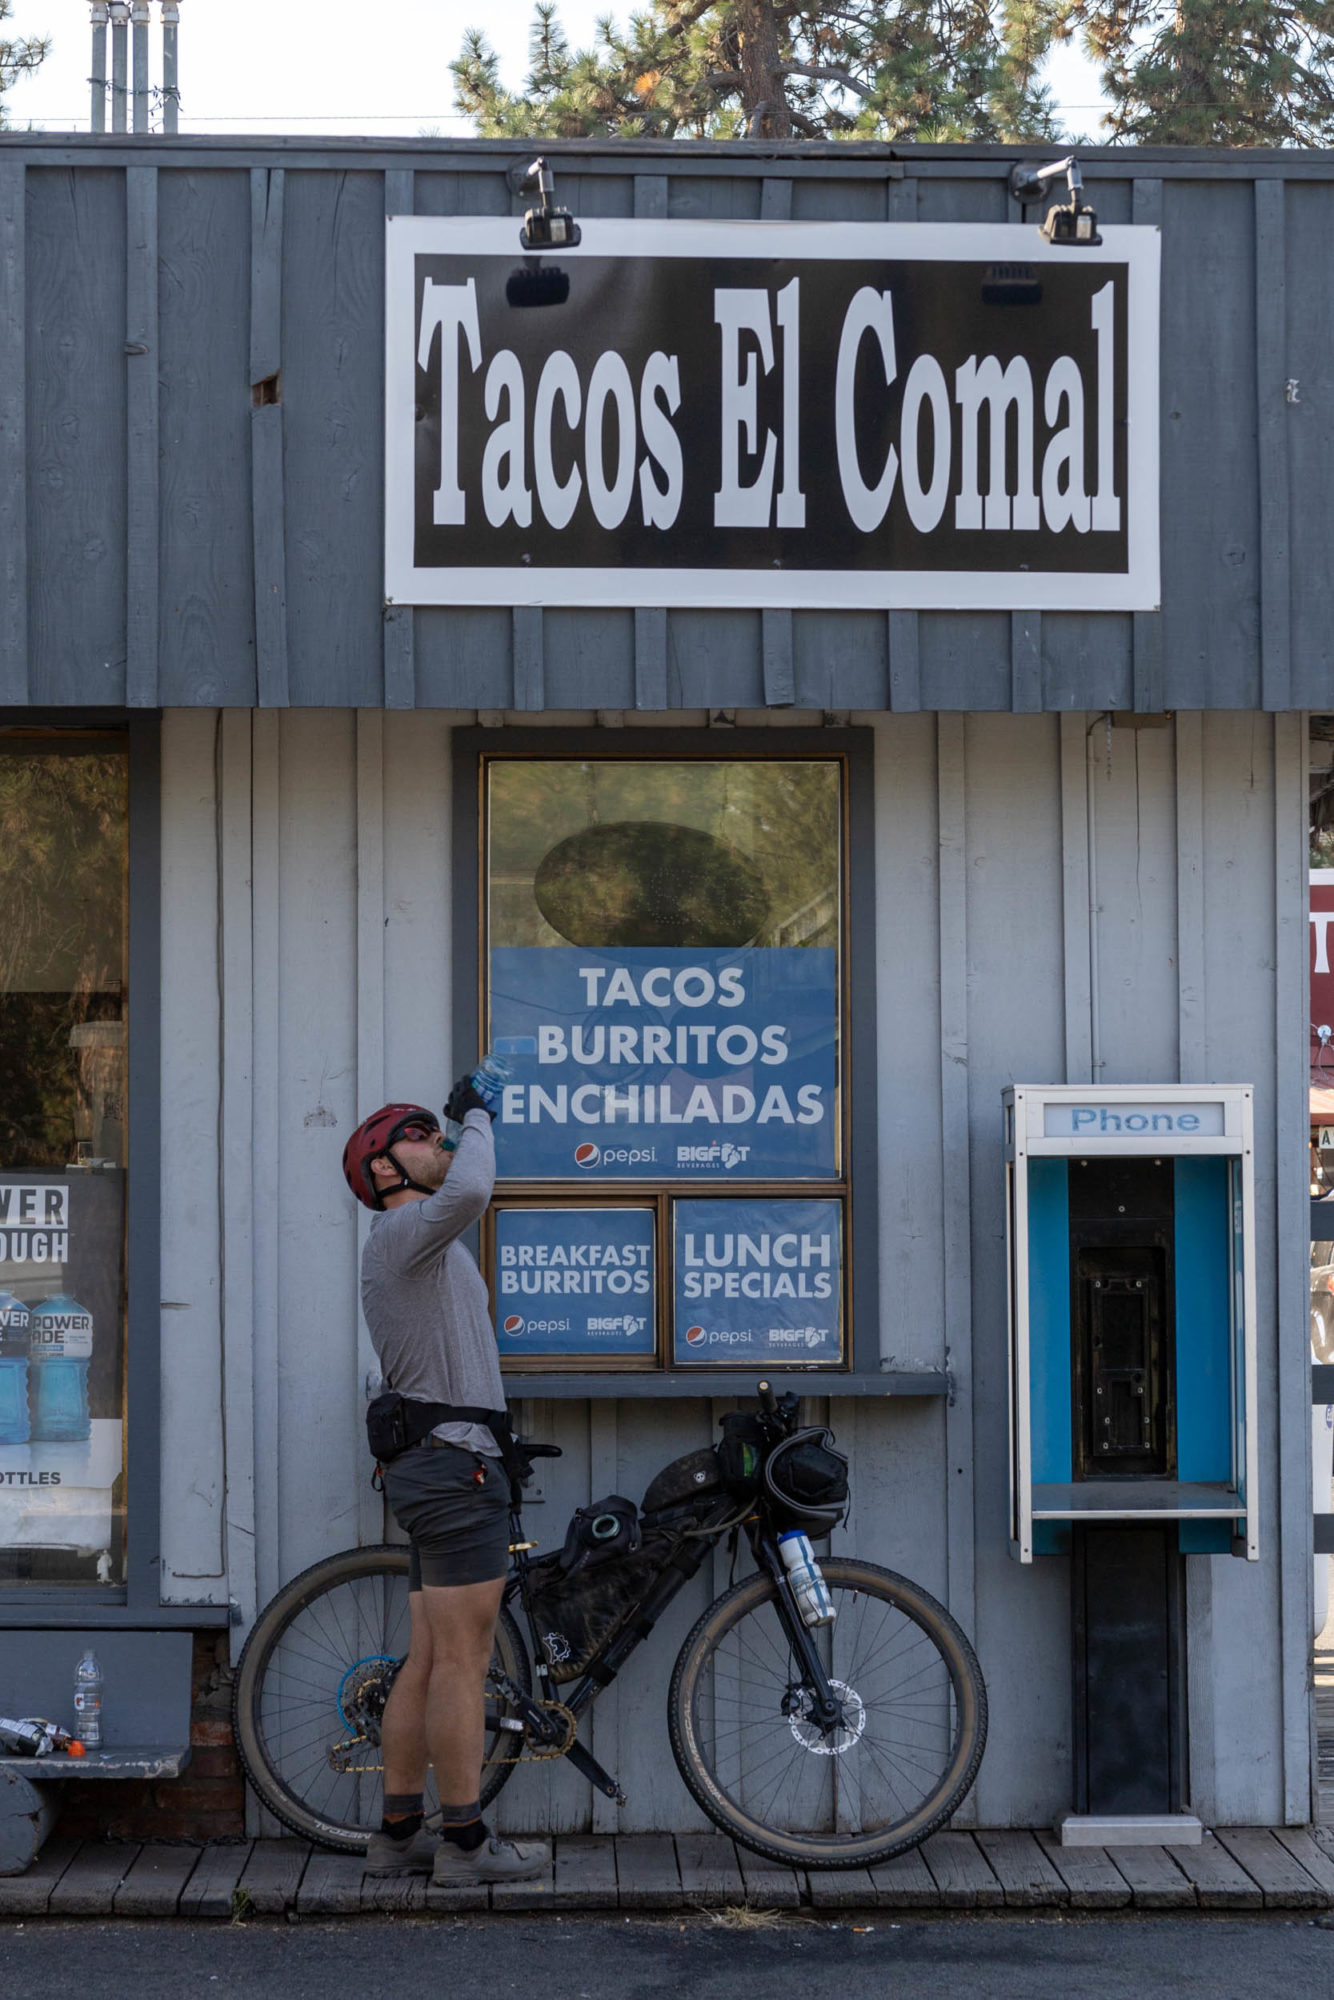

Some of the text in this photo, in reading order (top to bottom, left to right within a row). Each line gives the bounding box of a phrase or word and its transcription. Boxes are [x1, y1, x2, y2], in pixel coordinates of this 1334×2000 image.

[417, 276, 1121, 534] Tacos El Comal
[578, 966, 746, 1008] TACOS
[538, 1024, 789, 1066] BURRITOS
[502, 1083, 825, 1125] ENCHILADAS
[1071, 1108, 1201, 1132] Phone
[603, 1145, 656, 1166] pepsi
[501, 1244, 651, 1267] BREAKFAST
[684, 1233, 831, 1268] LUNCH
[501, 1269, 651, 1295] BURRITOS
[683, 1272, 832, 1300] SPECIALS
[33, 1316, 90, 1330] POWER
[527, 1318, 570, 1334] pepsi
[709, 1329, 752, 1345] pepsi
